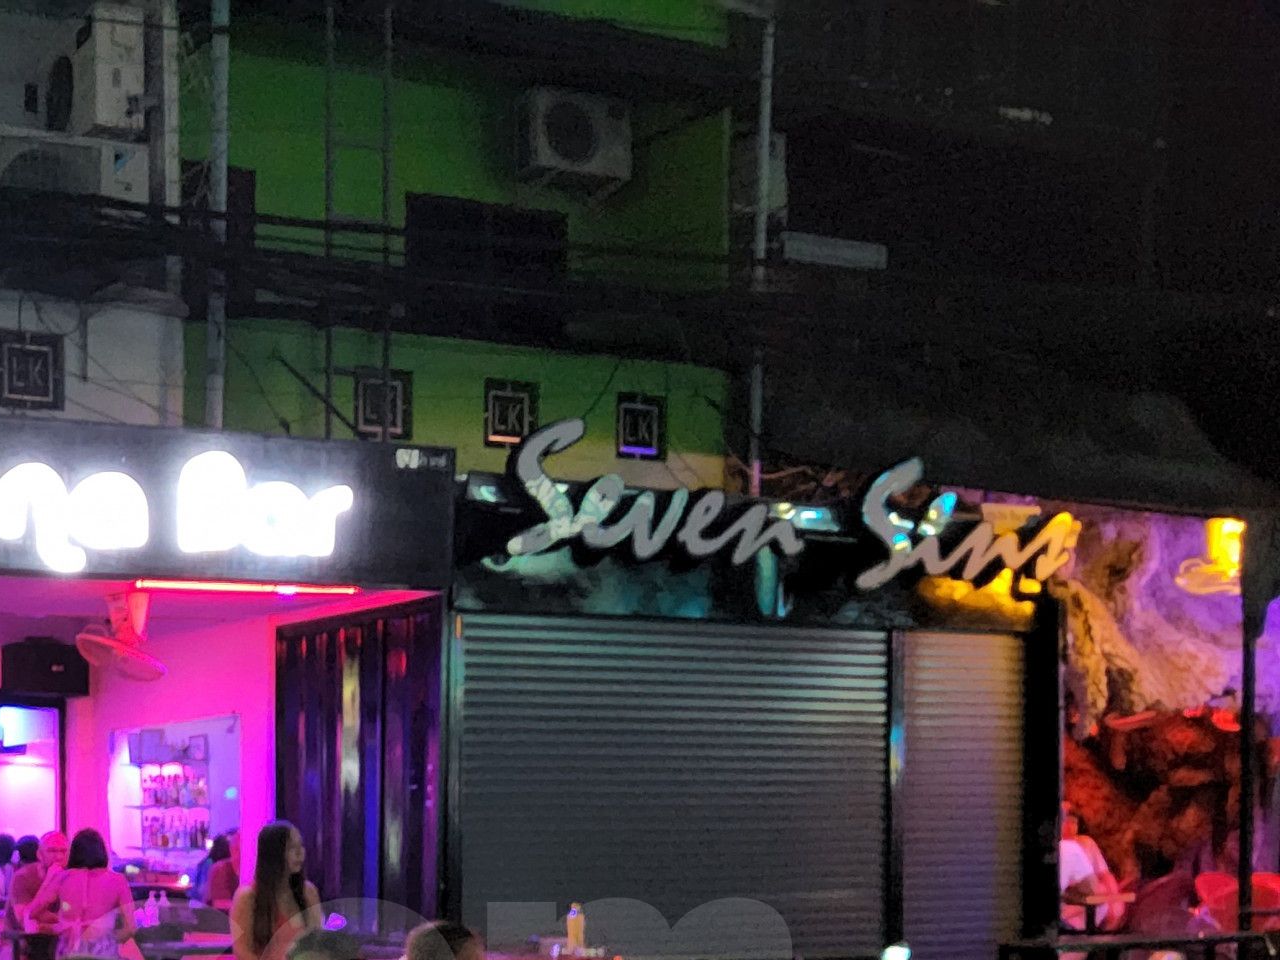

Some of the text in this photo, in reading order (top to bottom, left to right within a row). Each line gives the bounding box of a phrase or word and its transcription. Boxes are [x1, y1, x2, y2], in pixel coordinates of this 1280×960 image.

[11, 355, 45, 388] LK
[494, 402, 522, 432] LK
[626, 413, 651, 442] LK
[176, 451, 354, 558] Bar
[507, 418, 805, 565] Seven
